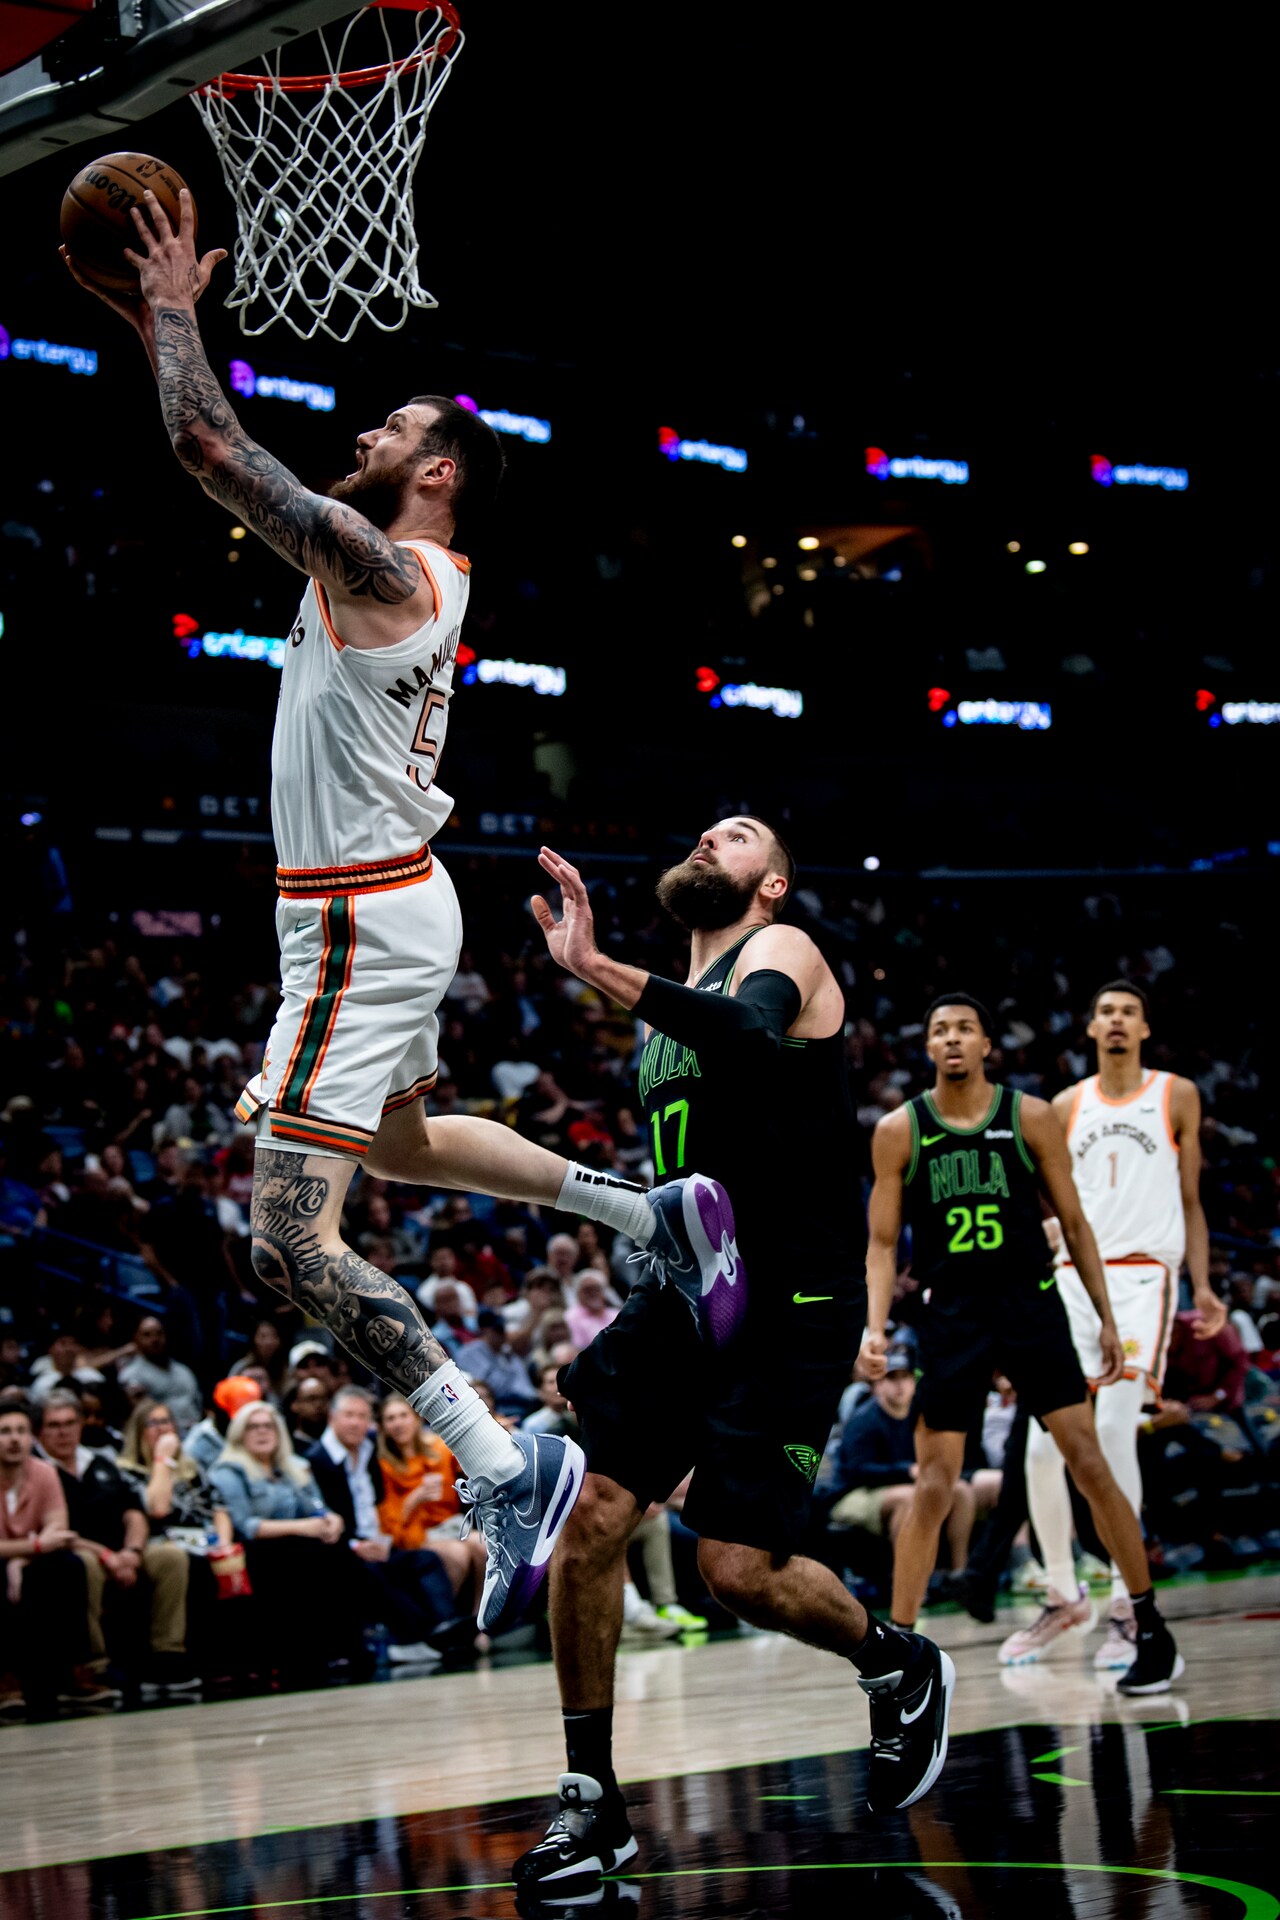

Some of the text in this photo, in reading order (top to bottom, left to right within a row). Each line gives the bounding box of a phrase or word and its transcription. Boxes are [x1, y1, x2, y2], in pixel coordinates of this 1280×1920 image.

[651, 1099, 689, 1175] 17
[928, 1149, 1011, 1204] NOLA
[1108, 1151, 1119, 1189] 1
[946, 1204, 1004, 1254] 25
[367, 1319, 399, 1349] 23
